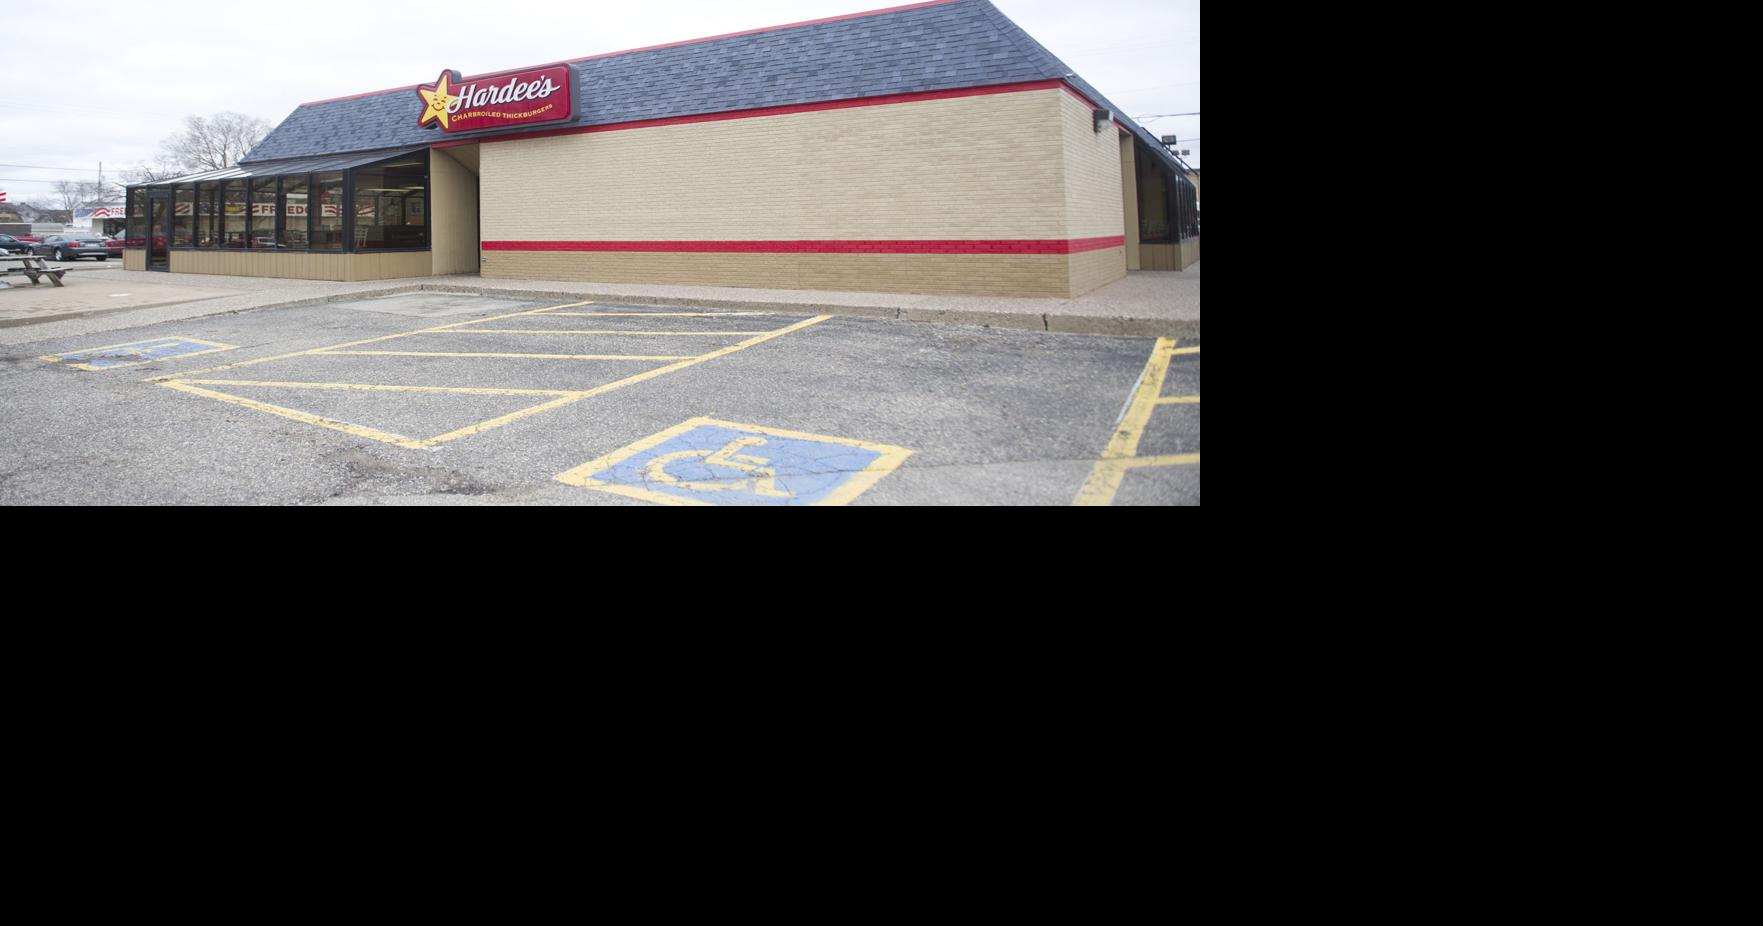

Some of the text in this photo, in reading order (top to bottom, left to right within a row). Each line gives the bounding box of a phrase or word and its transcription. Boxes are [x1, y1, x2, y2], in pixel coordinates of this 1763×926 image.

[446, 75, 560, 113] Hardee's
[451, 104, 553, 122] CHARBROILED THICKBURGERS
